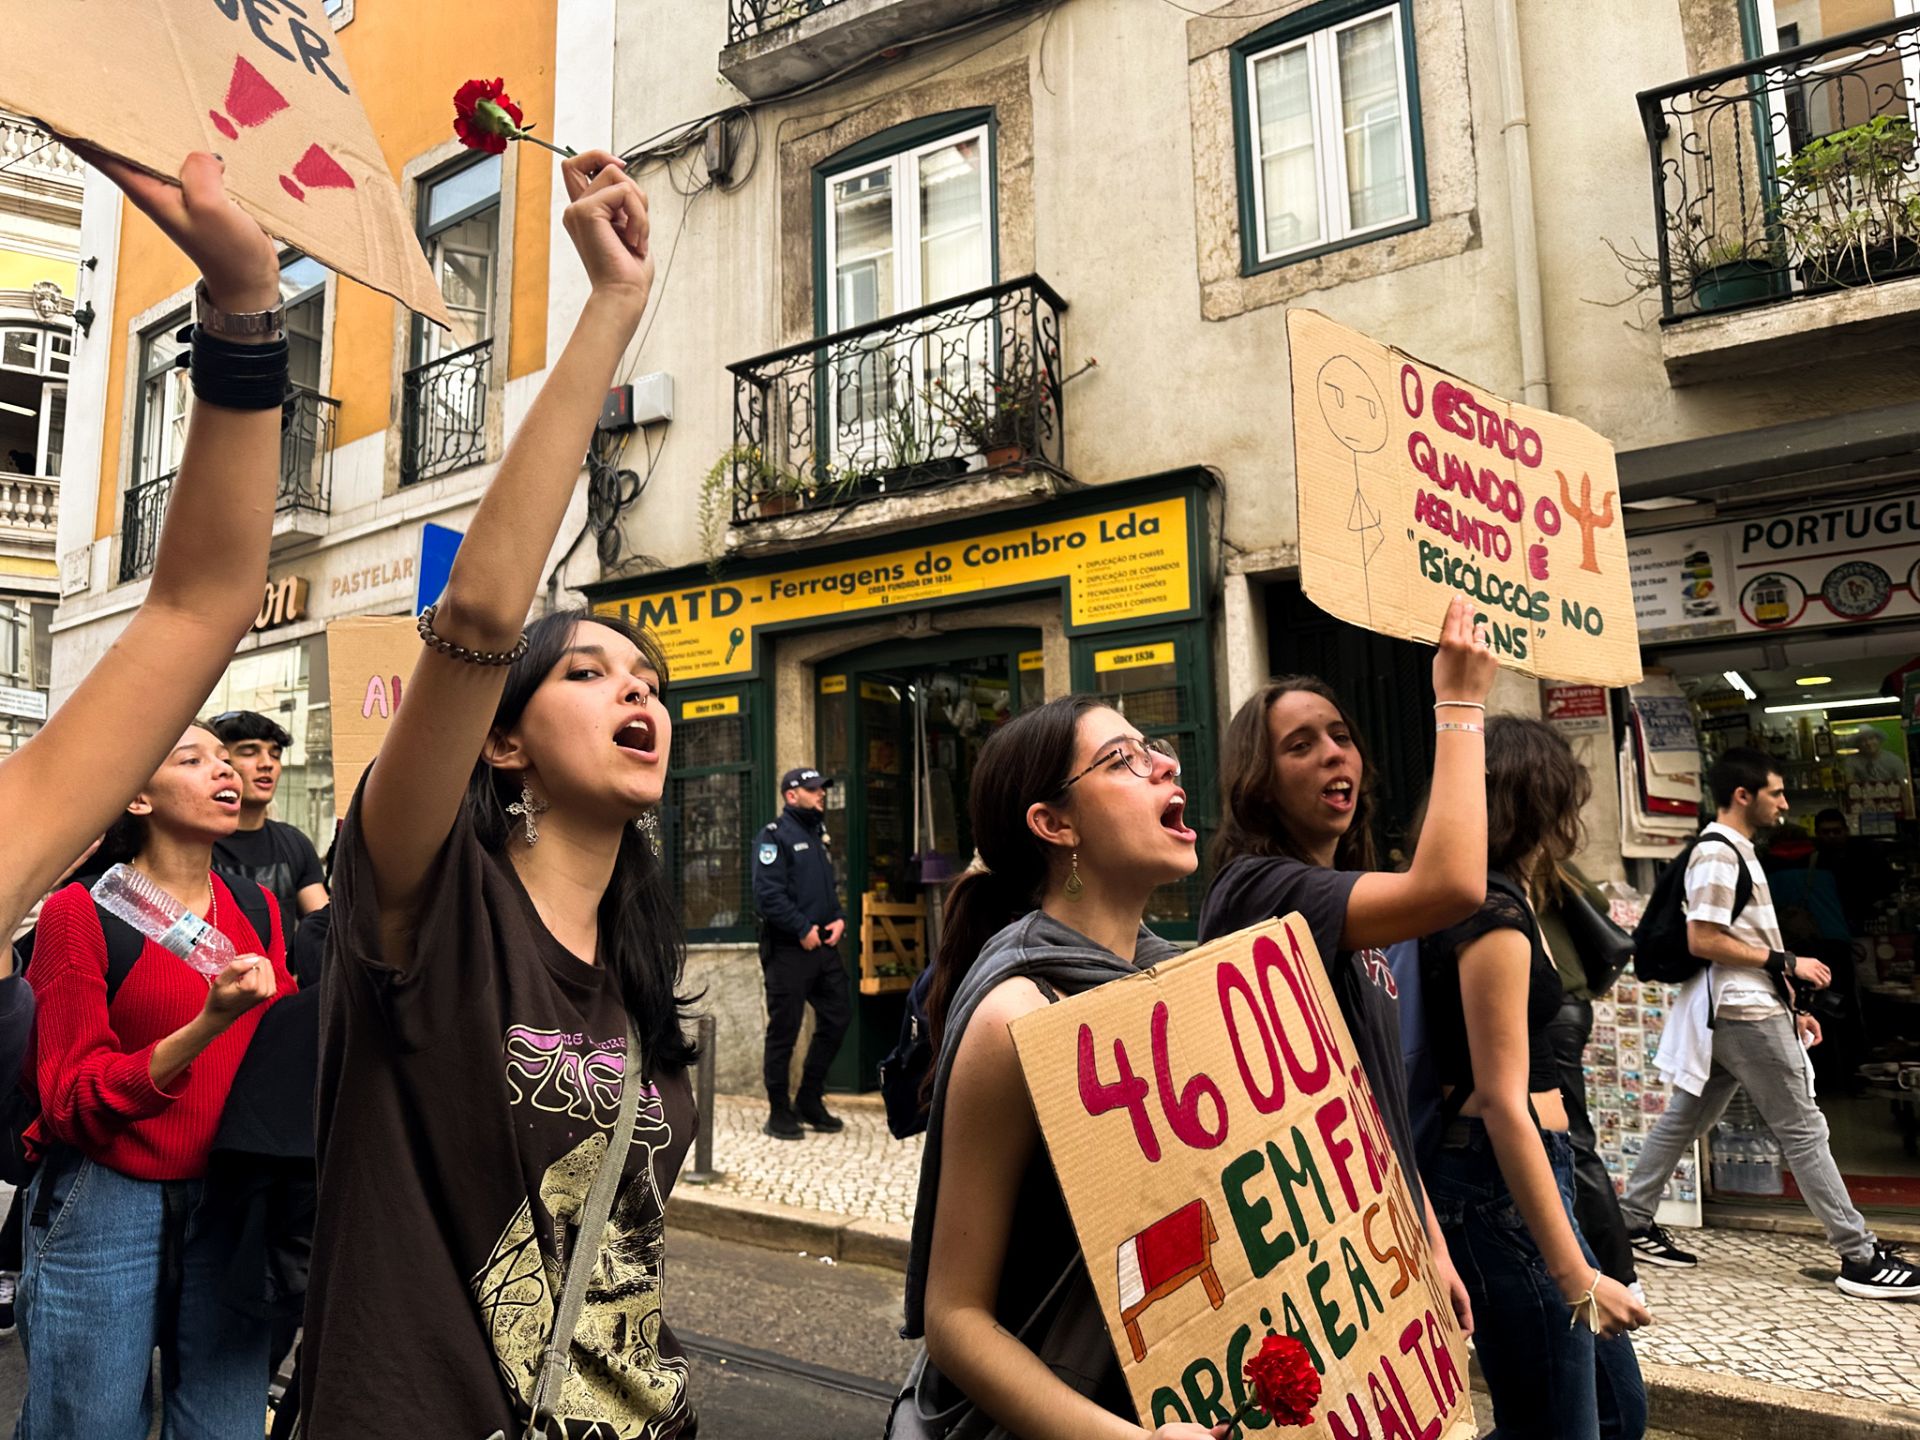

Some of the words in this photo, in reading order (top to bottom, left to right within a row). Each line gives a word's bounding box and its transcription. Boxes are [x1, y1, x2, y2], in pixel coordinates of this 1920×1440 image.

[1401, 364, 1424, 418] O
[1432, 380, 1543, 468] ESTADO
[1408, 431, 1524, 523] QUANDO
[1534, 496, 1561, 536] O
[1415, 488, 1512, 562] ASSUNTO
[331, 556, 413, 598] PASTELAR
[770, 565, 904, 600] Ferragens
[914, 552, 952, 576] do
[963, 531, 1087, 567] Combro
[1099, 512, 1160, 543] Lda
[1562, 599, 1604, 636] NO
[1221, 1125, 1336, 1279] EM
[1339, 1236, 1385, 1331] A
